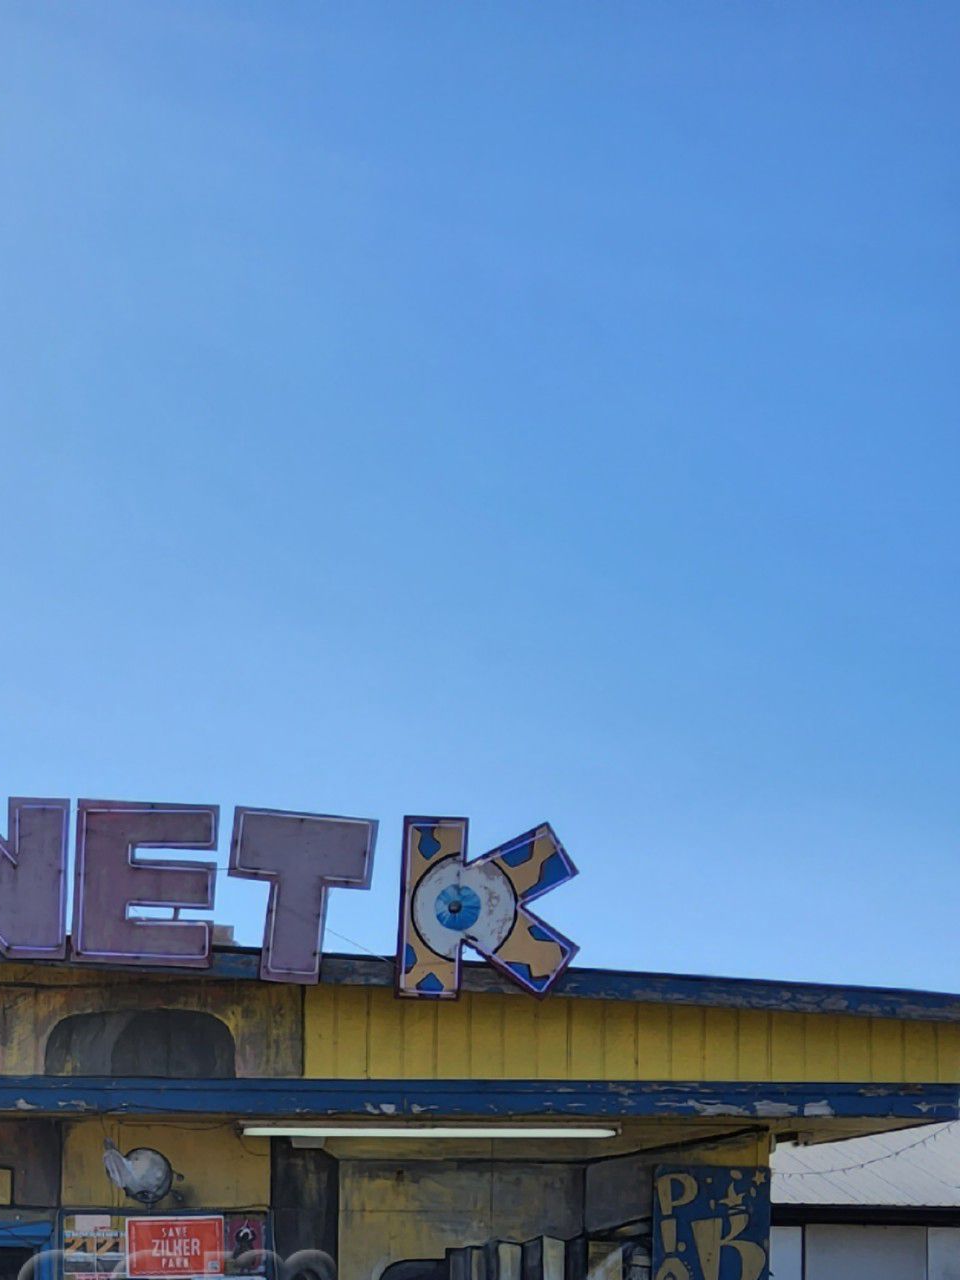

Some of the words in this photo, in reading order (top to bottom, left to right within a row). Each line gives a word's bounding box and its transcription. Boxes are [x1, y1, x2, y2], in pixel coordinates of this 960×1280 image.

[394, 815, 580, 1000] K
[161, 1226, 187, 1237] SAVE
[151, 1238, 200, 1257] ZILKER
[161, 1257, 189, 1268] PARK
